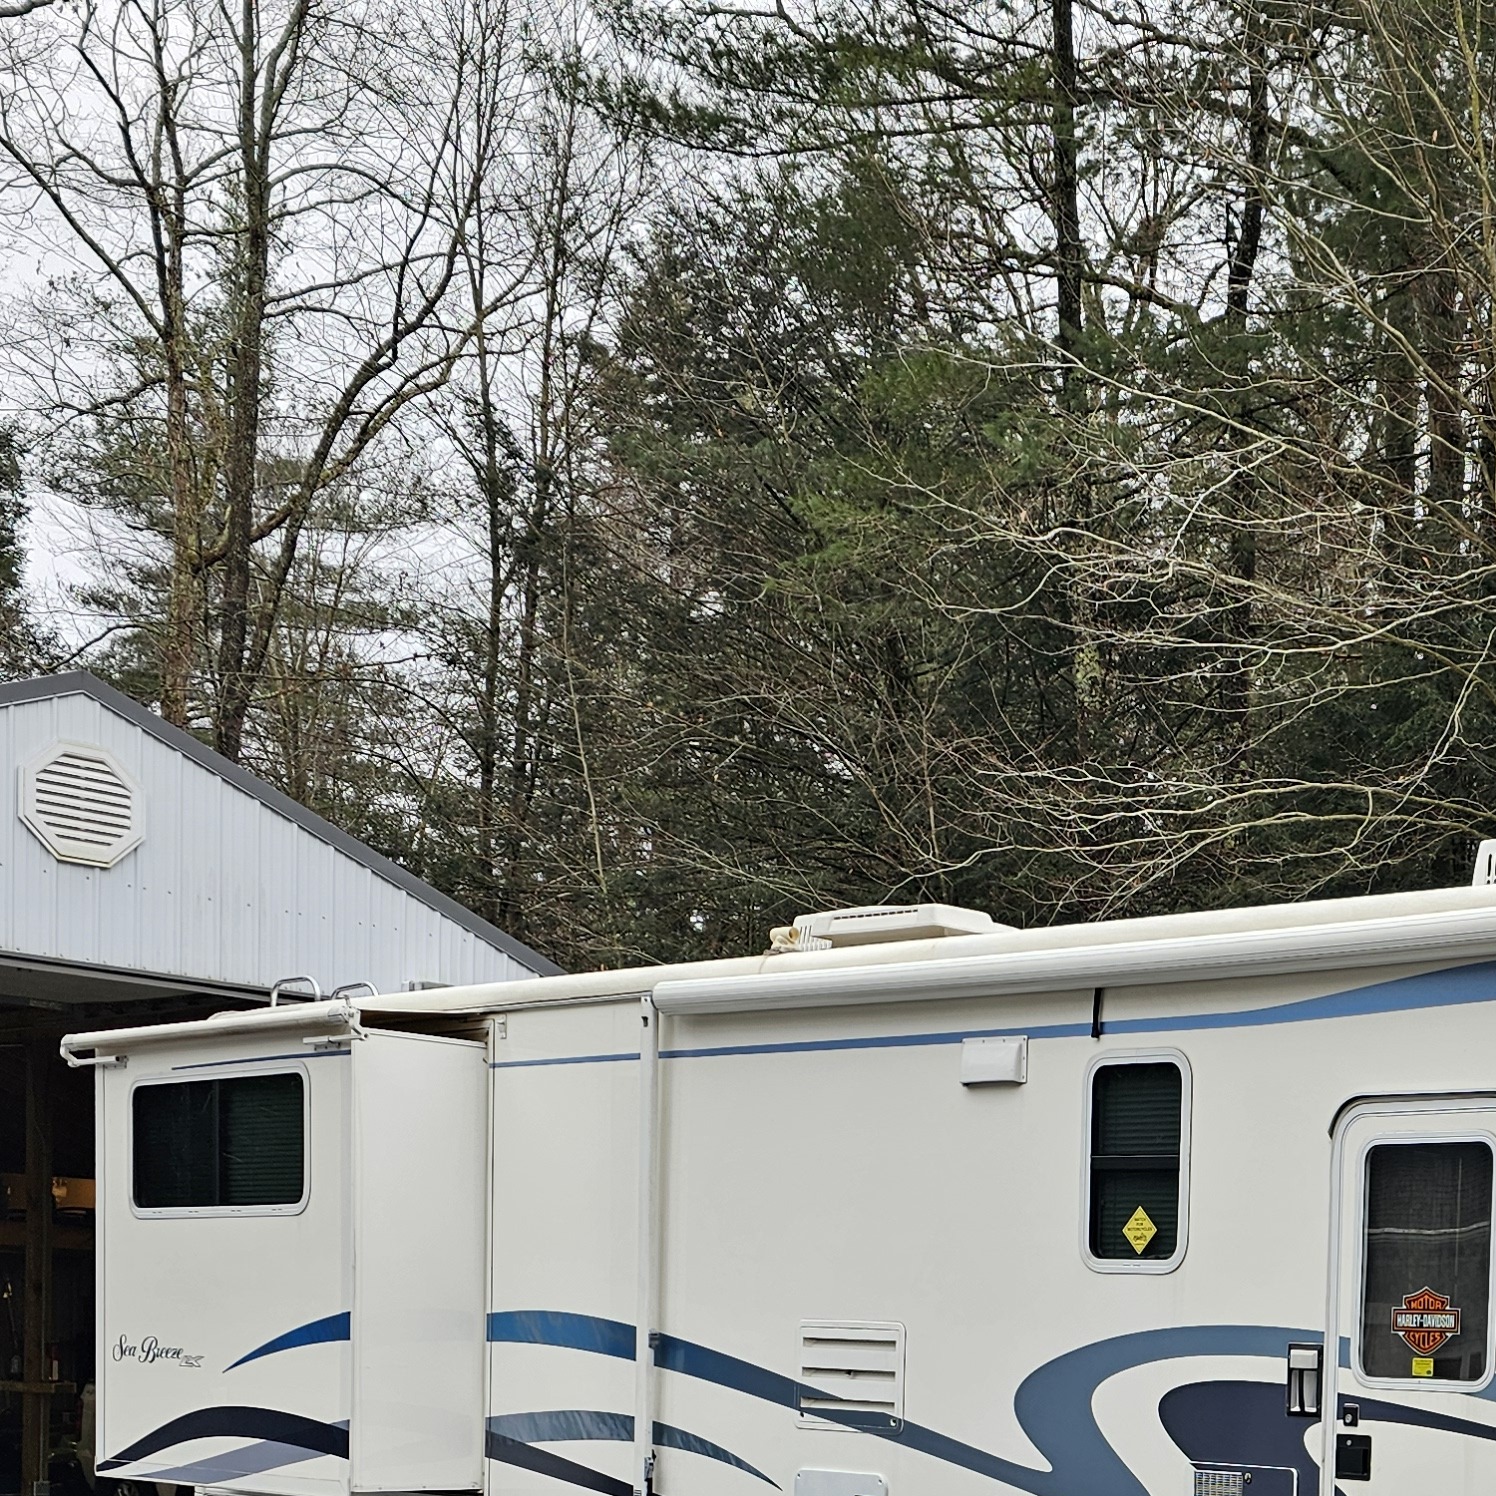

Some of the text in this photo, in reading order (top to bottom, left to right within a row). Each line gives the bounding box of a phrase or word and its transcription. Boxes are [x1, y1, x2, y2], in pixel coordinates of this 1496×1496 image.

[1411, 1295, 1442, 1309] MOTOR
[1397, 1314, 1455, 1328] HARLEY-DAVIDSON
[1409, 1332, 1441, 1348] CYCLES
[112, 1334, 137, 1362] Sea
[138, 1336, 183, 1363] Breeze
